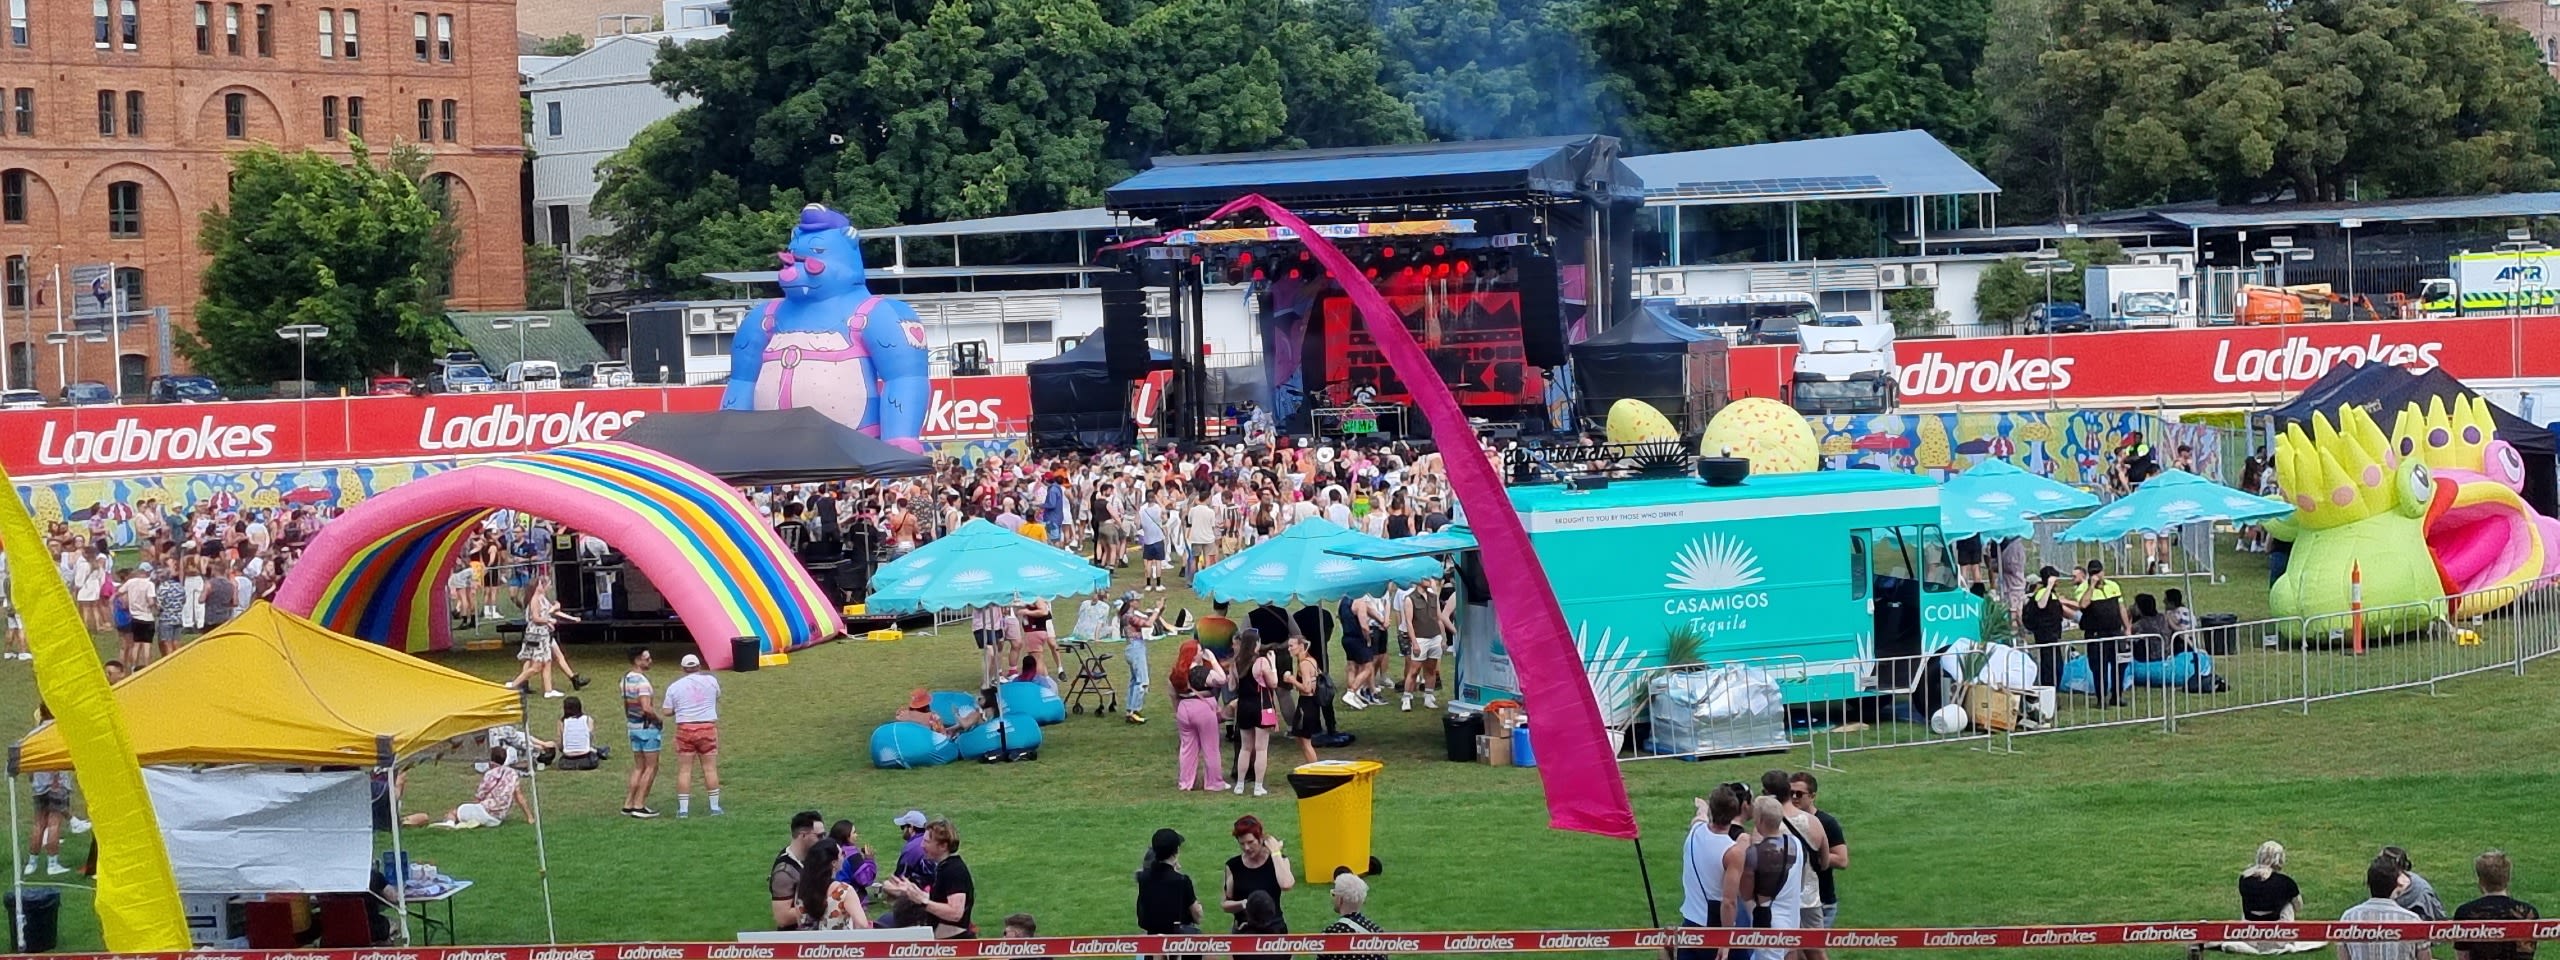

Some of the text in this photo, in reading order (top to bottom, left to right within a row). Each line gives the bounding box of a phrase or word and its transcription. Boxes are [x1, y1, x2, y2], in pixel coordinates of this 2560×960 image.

[2495, 265, 2542, 281] AMR
[1896, 349, 2075, 396] dbrokes
[38, 415, 276, 465] Ladbrokes
[1664, 593, 1769, 615] CASAMIGOS
[1924, 603, 1979, 622] COLIN
[1690, 613, 1747, 638] Tequila
[441, 950, 507, 960] Ladbrokes
[530, 948, 595, 960] Ladbrokes
[618, 946, 684, 960] Ladbrokes
[708, 945, 774, 959] Ladbrokes
[798, 944, 865, 958] Ladbrokes
[889, 943, 957, 957] Ladbrokes
[979, 941, 1046, 955] Ladbrokes
[1070, 939, 1138, 953] Ladbrokes
[1162, 937, 1231, 952] Ladbrokes
[1256, 937, 1325, 951] Ladbrokes
[1350, 936, 1420, 950] Ladbrokes
[1444, 935, 1515, 949] Ladbrokes
[1539, 933, 1610, 948] Ladbrokes
[1729, 931, 1801, 946] Ladbrokes
[1825, 931, 1898, 946] Ladbrokes
[1924, 931, 1997, 946] Ladbrokes
[2022, 929, 2097, 943] Ladbrokes
[2123, 926, 2197, 940] Ladbrokes
[2224, 924, 2299, 939] Ladbrokes
[2326, 925, 2402, 940] Ladbrokes
[2429, 924, 2506, 938] Ladbrokes
